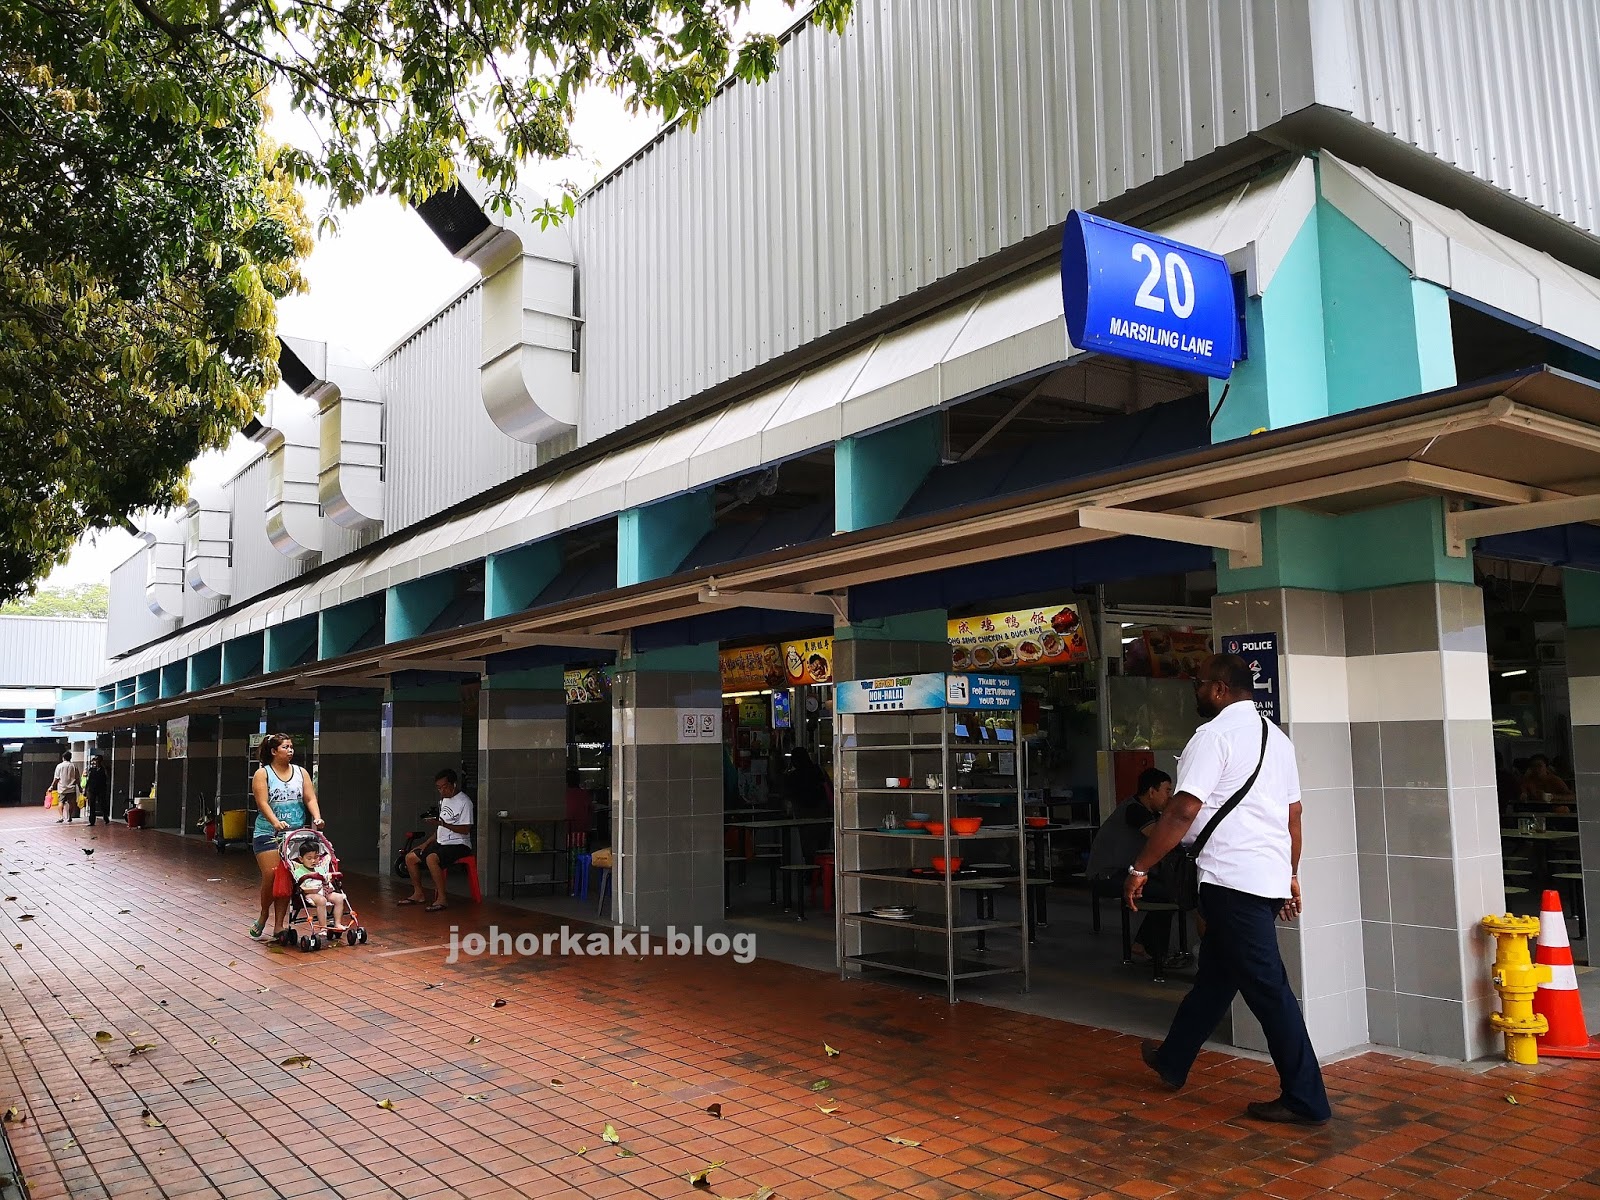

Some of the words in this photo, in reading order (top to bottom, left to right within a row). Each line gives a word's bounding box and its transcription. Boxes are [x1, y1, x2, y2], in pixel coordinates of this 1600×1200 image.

[1131, 242, 1195, 319] 20
[1109, 317, 1179, 349] MARSILING
[1181, 334, 1214, 357] LANE
[948, 637, 960, 645] ONG
[961, 636, 977, 645] SENG
[978, 634, 1003, 643] CHICKEN
[1011, 629, 1027, 639] DUCK
[1029, 626, 1043, 634] RICE
[1242, 641, 1273, 651] POLICE
[874, 679, 895, 689] RETURN
[896, 677, 912, 687] POINT
[977, 678, 996, 686] THANK
[869, 688, 903, 701] NON-HALAL
[985, 687, 1016, 696] RETURNING
[1265, 701, 1273, 709] IN
